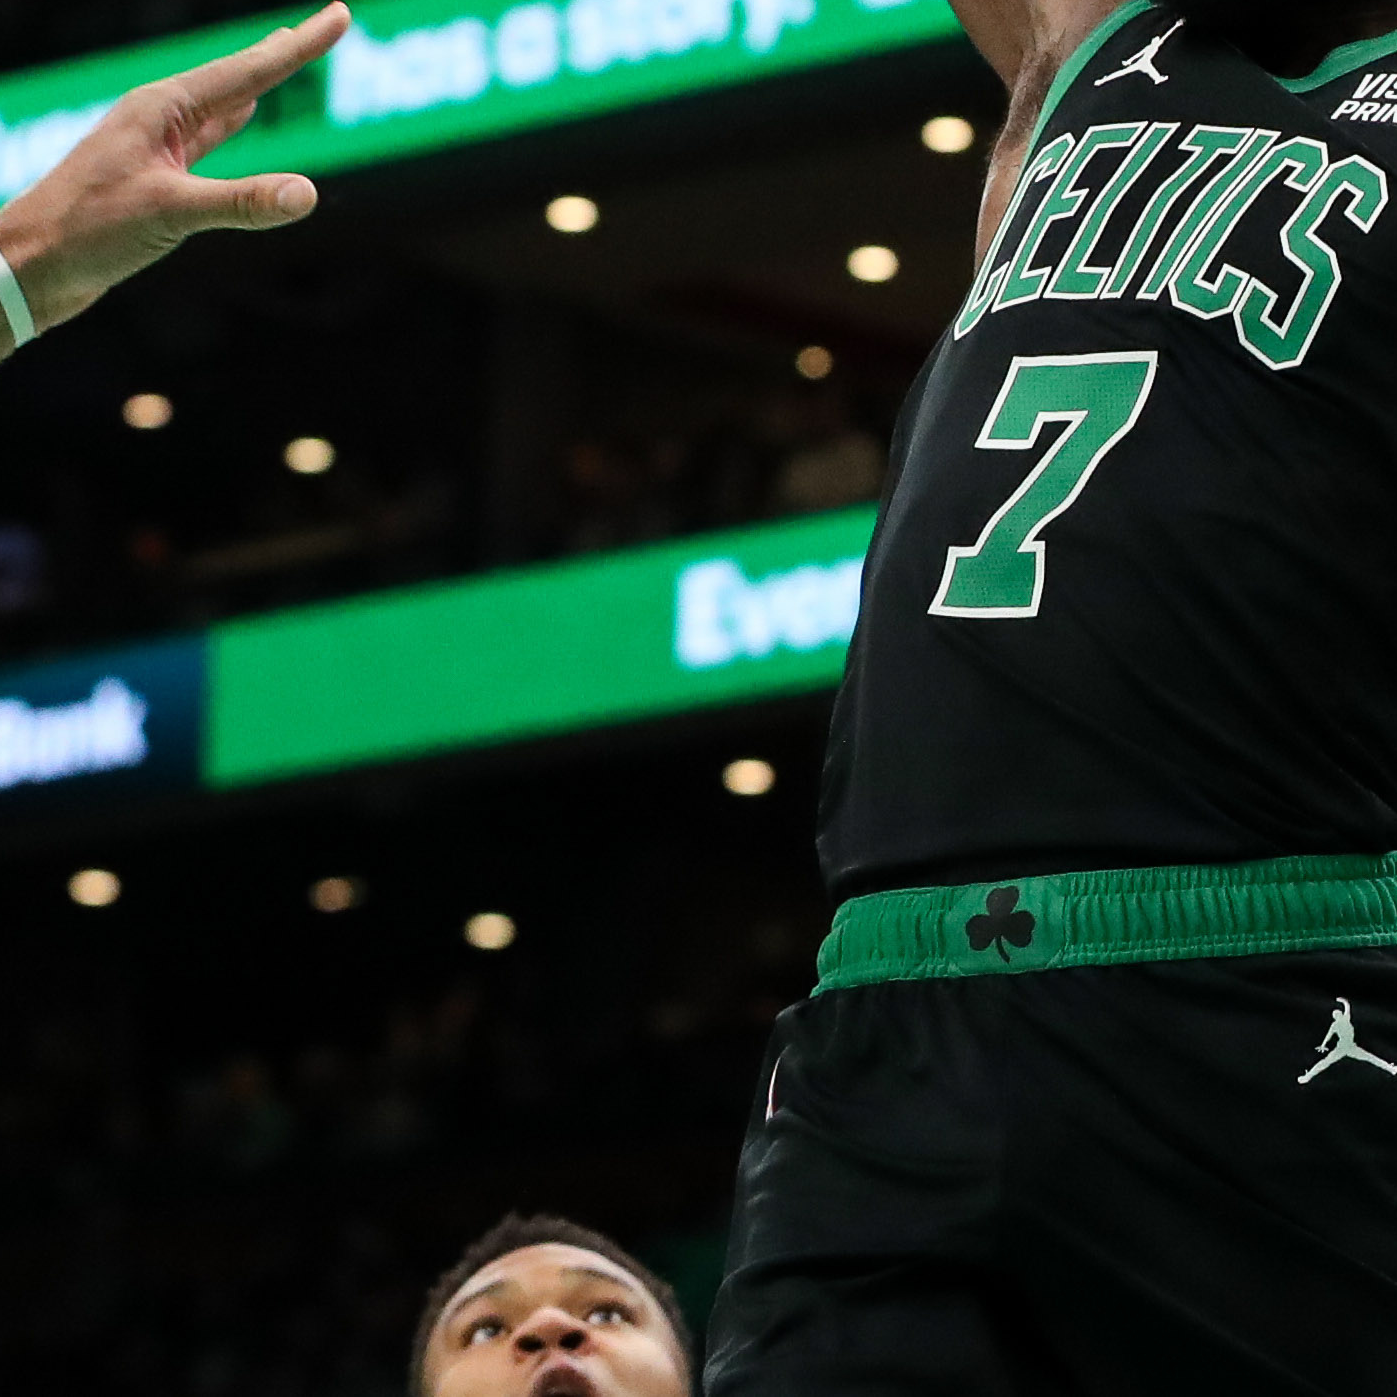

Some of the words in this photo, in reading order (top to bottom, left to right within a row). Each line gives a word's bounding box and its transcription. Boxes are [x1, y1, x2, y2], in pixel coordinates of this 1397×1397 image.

[325, 20, 491, 123] has
[494, 2, 560, 88] a
[954, 120, 1389, 371] CELTICS
[927, 350, 1159, 619] 7
